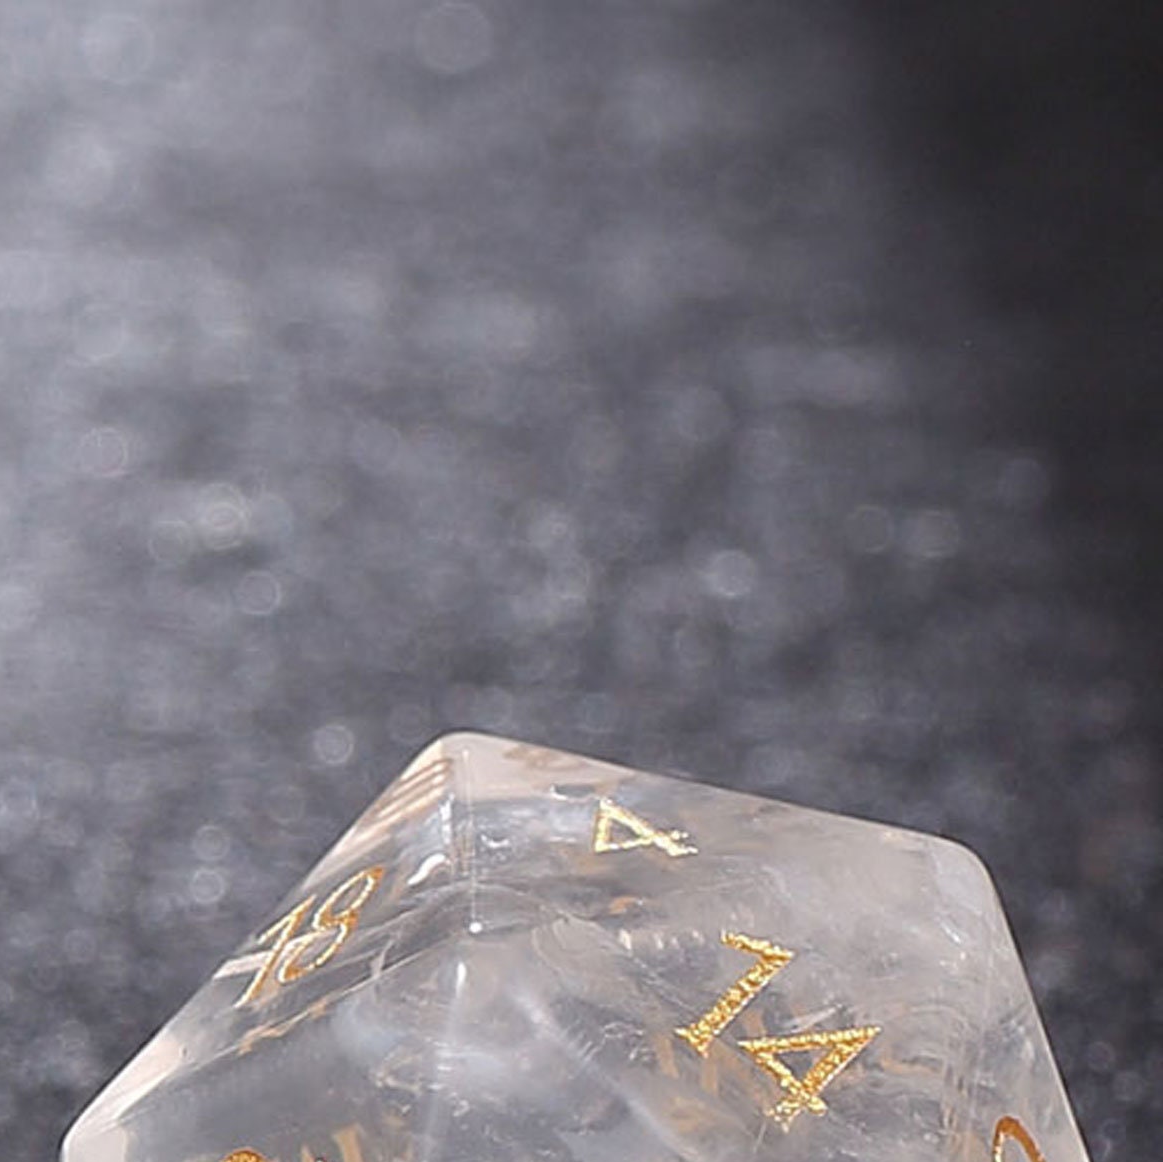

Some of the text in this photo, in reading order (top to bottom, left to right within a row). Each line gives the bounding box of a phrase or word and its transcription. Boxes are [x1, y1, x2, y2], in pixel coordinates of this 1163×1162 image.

[593, 797, 699, 857] 4
[232, 866, 386, 1010] 18
[673, 928, 882, 1133] 14
